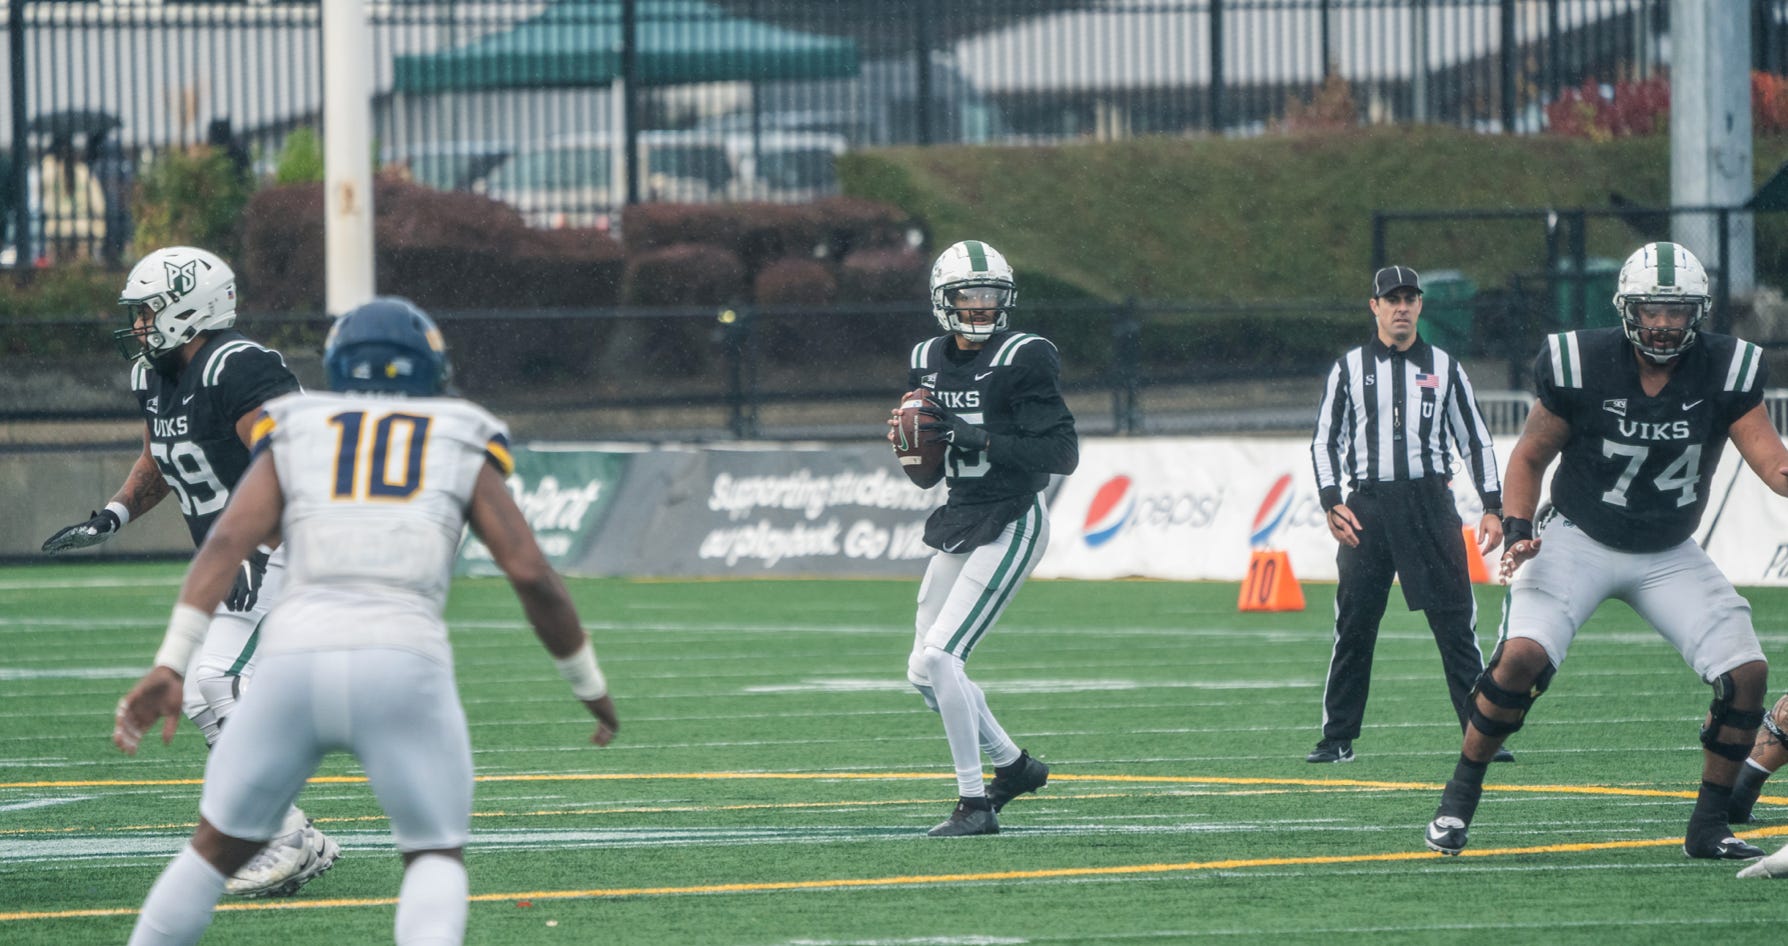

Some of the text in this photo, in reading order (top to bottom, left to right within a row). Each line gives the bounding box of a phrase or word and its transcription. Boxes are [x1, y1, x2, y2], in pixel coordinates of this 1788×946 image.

[1365, 374, 1375, 386] S
[154, 416, 188, 437] VIKS
[1422, 402, 1434, 418] U
[1619, 419, 1689, 440] VIKS
[327, 411, 433, 502] 10
[1602, 438, 1702, 508] 74
[150, 441, 229, 516] 59
[1125, 487, 1225, 536] pepsi
[844, 520, 890, 560] Go
[1249, 558, 1276, 604] 10
